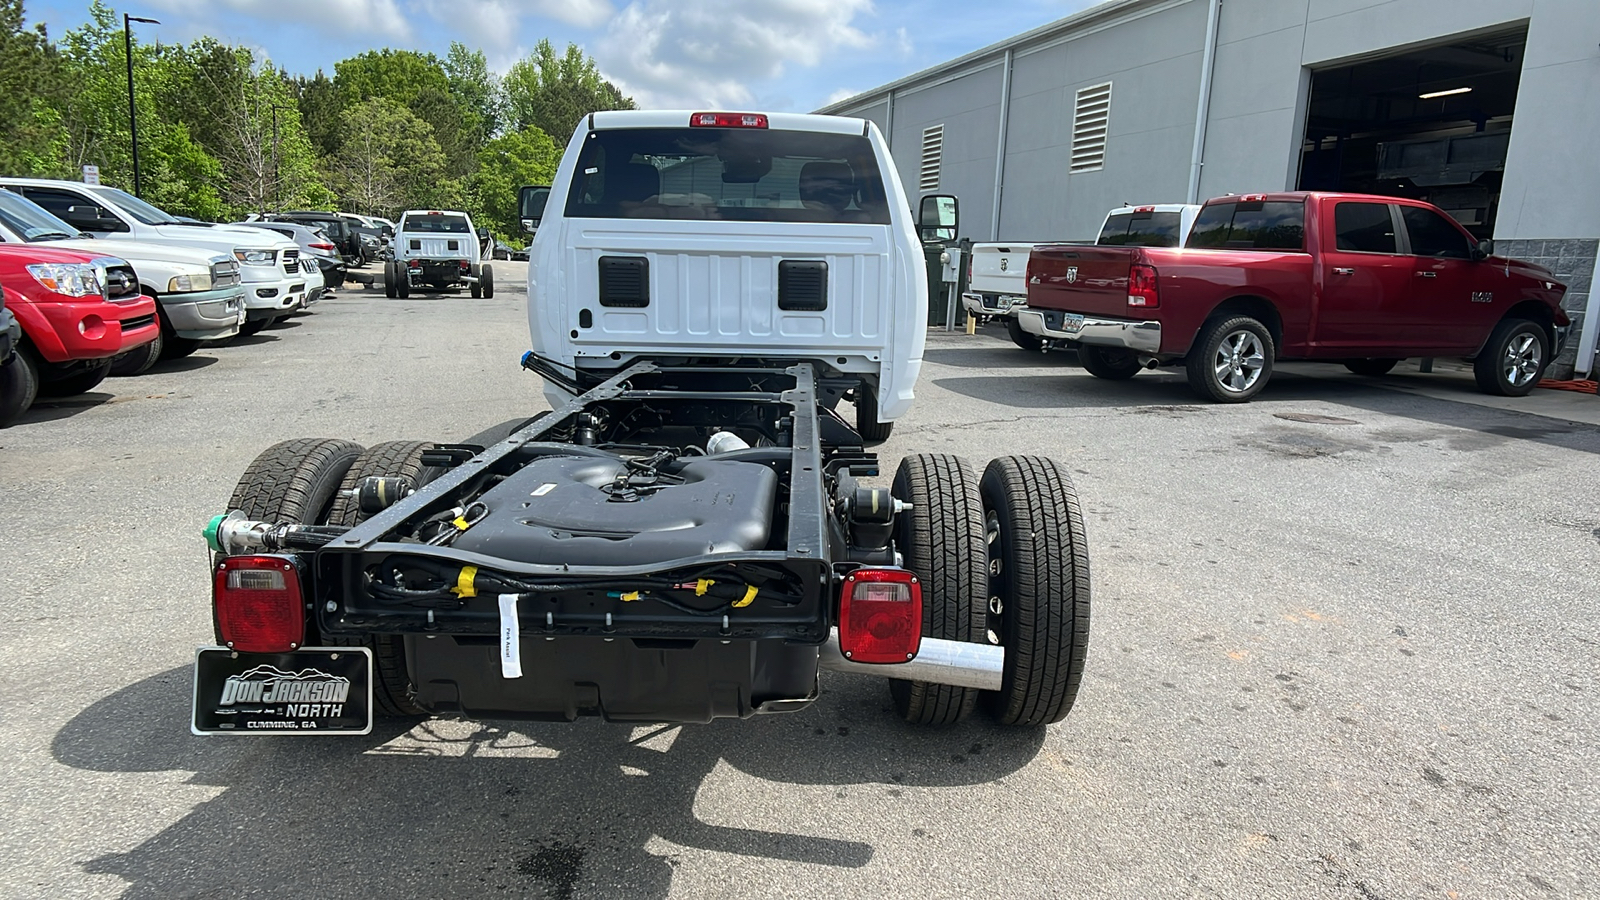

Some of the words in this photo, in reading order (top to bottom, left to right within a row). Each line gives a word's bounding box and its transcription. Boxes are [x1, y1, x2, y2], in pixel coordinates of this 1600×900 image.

[220, 680, 264, 705] DON
[263, 680, 350, 703] JACKSON
[286, 704, 343, 717] NORTH
[247, 721, 299, 730] CUMMING,
[302, 721, 317, 729] GA
